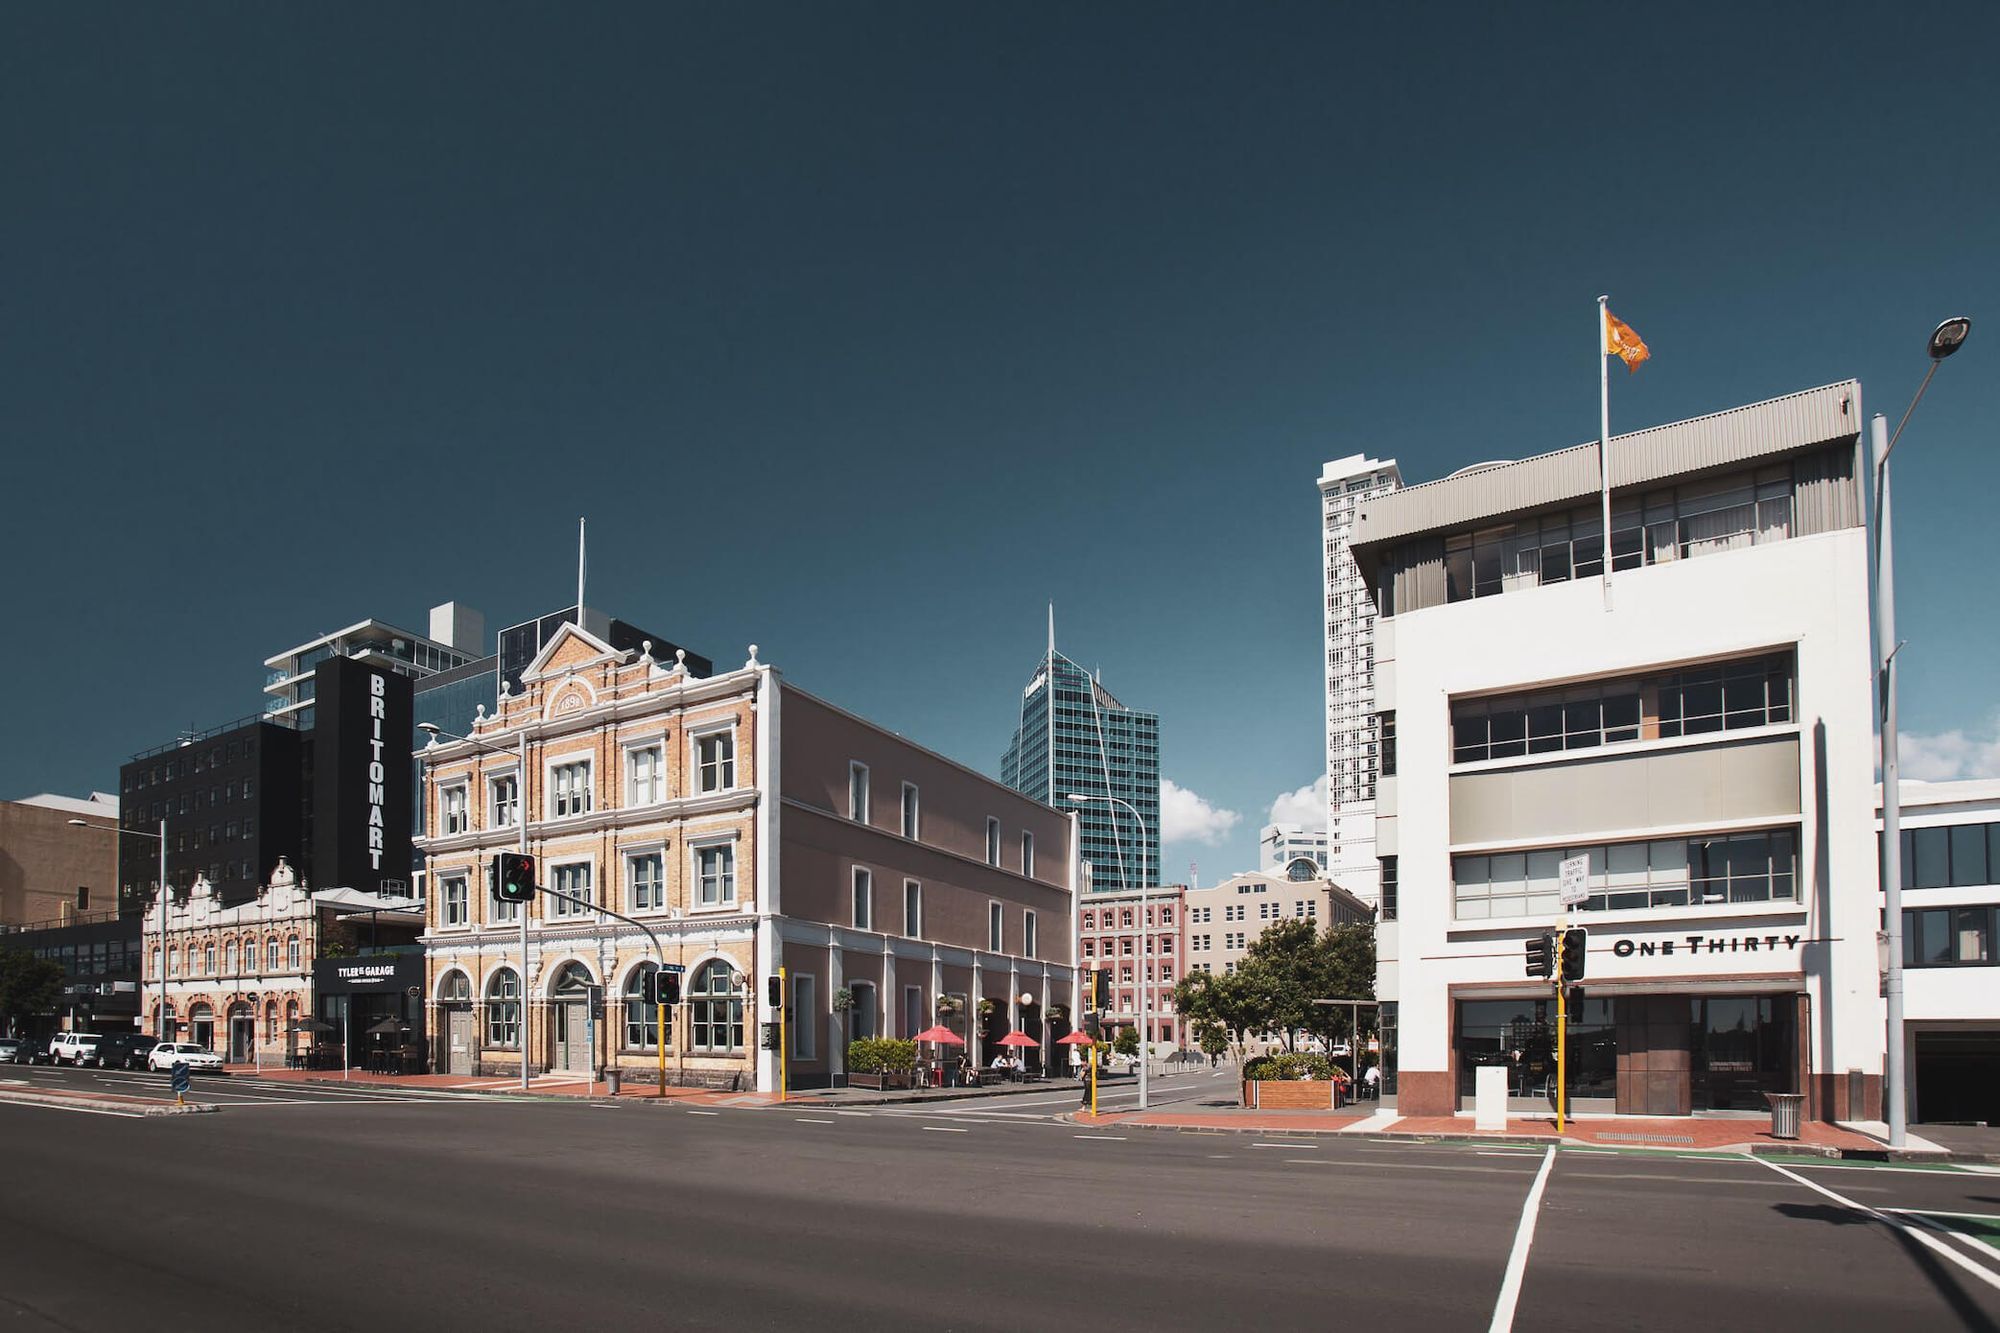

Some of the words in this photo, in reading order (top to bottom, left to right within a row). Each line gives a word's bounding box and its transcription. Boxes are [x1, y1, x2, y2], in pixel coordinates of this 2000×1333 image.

[369, 673, 385, 871] BRITOMART
[338, 967, 359, 977] TYLER
[365, 966, 395, 976] GARAGE
